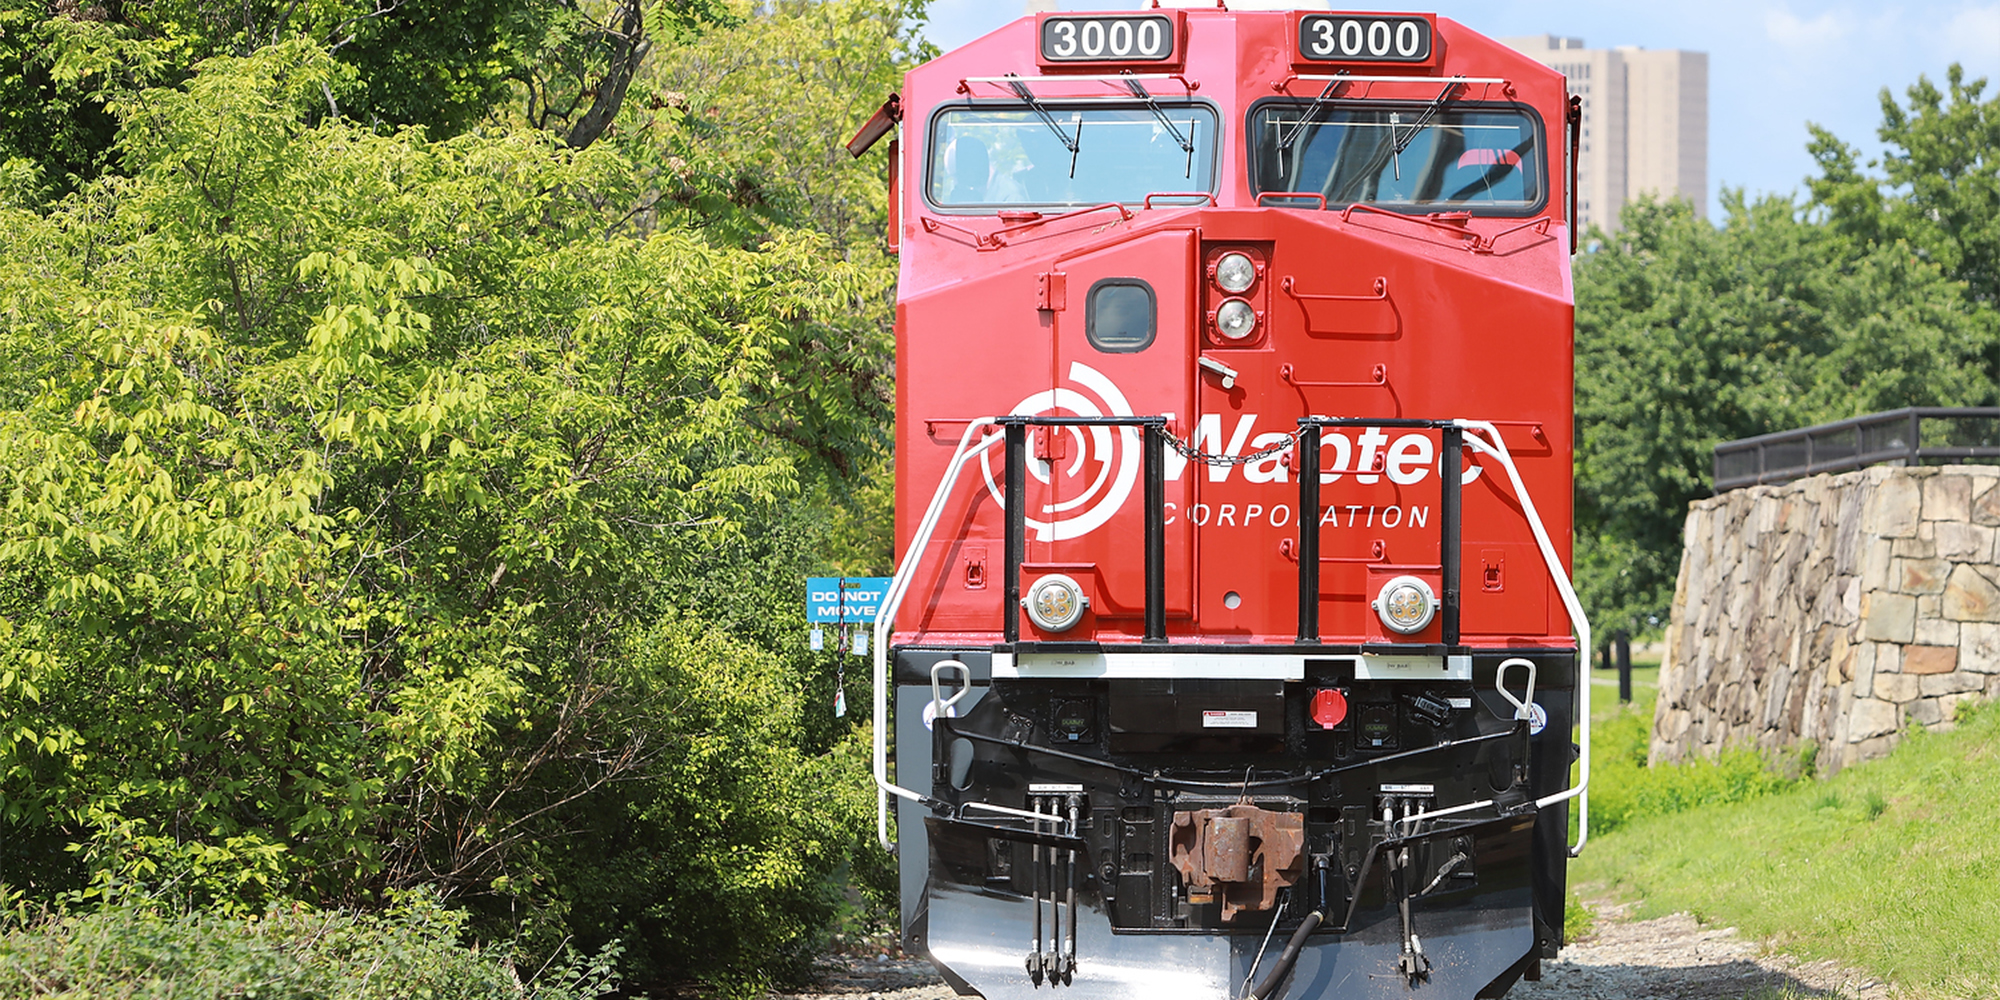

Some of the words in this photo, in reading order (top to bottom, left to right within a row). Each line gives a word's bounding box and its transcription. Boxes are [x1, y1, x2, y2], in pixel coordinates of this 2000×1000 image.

[1053, 19, 1161, 57] 3000
[1311, 19, 1419, 57] 3000
[1161, 412, 1485, 485] Wabtec
[1164, 502, 1429, 528] CORPOATION
[812, 591, 838, 602] DO
[844, 591, 882, 602] NOT
[817, 606, 877, 616] MOVE
